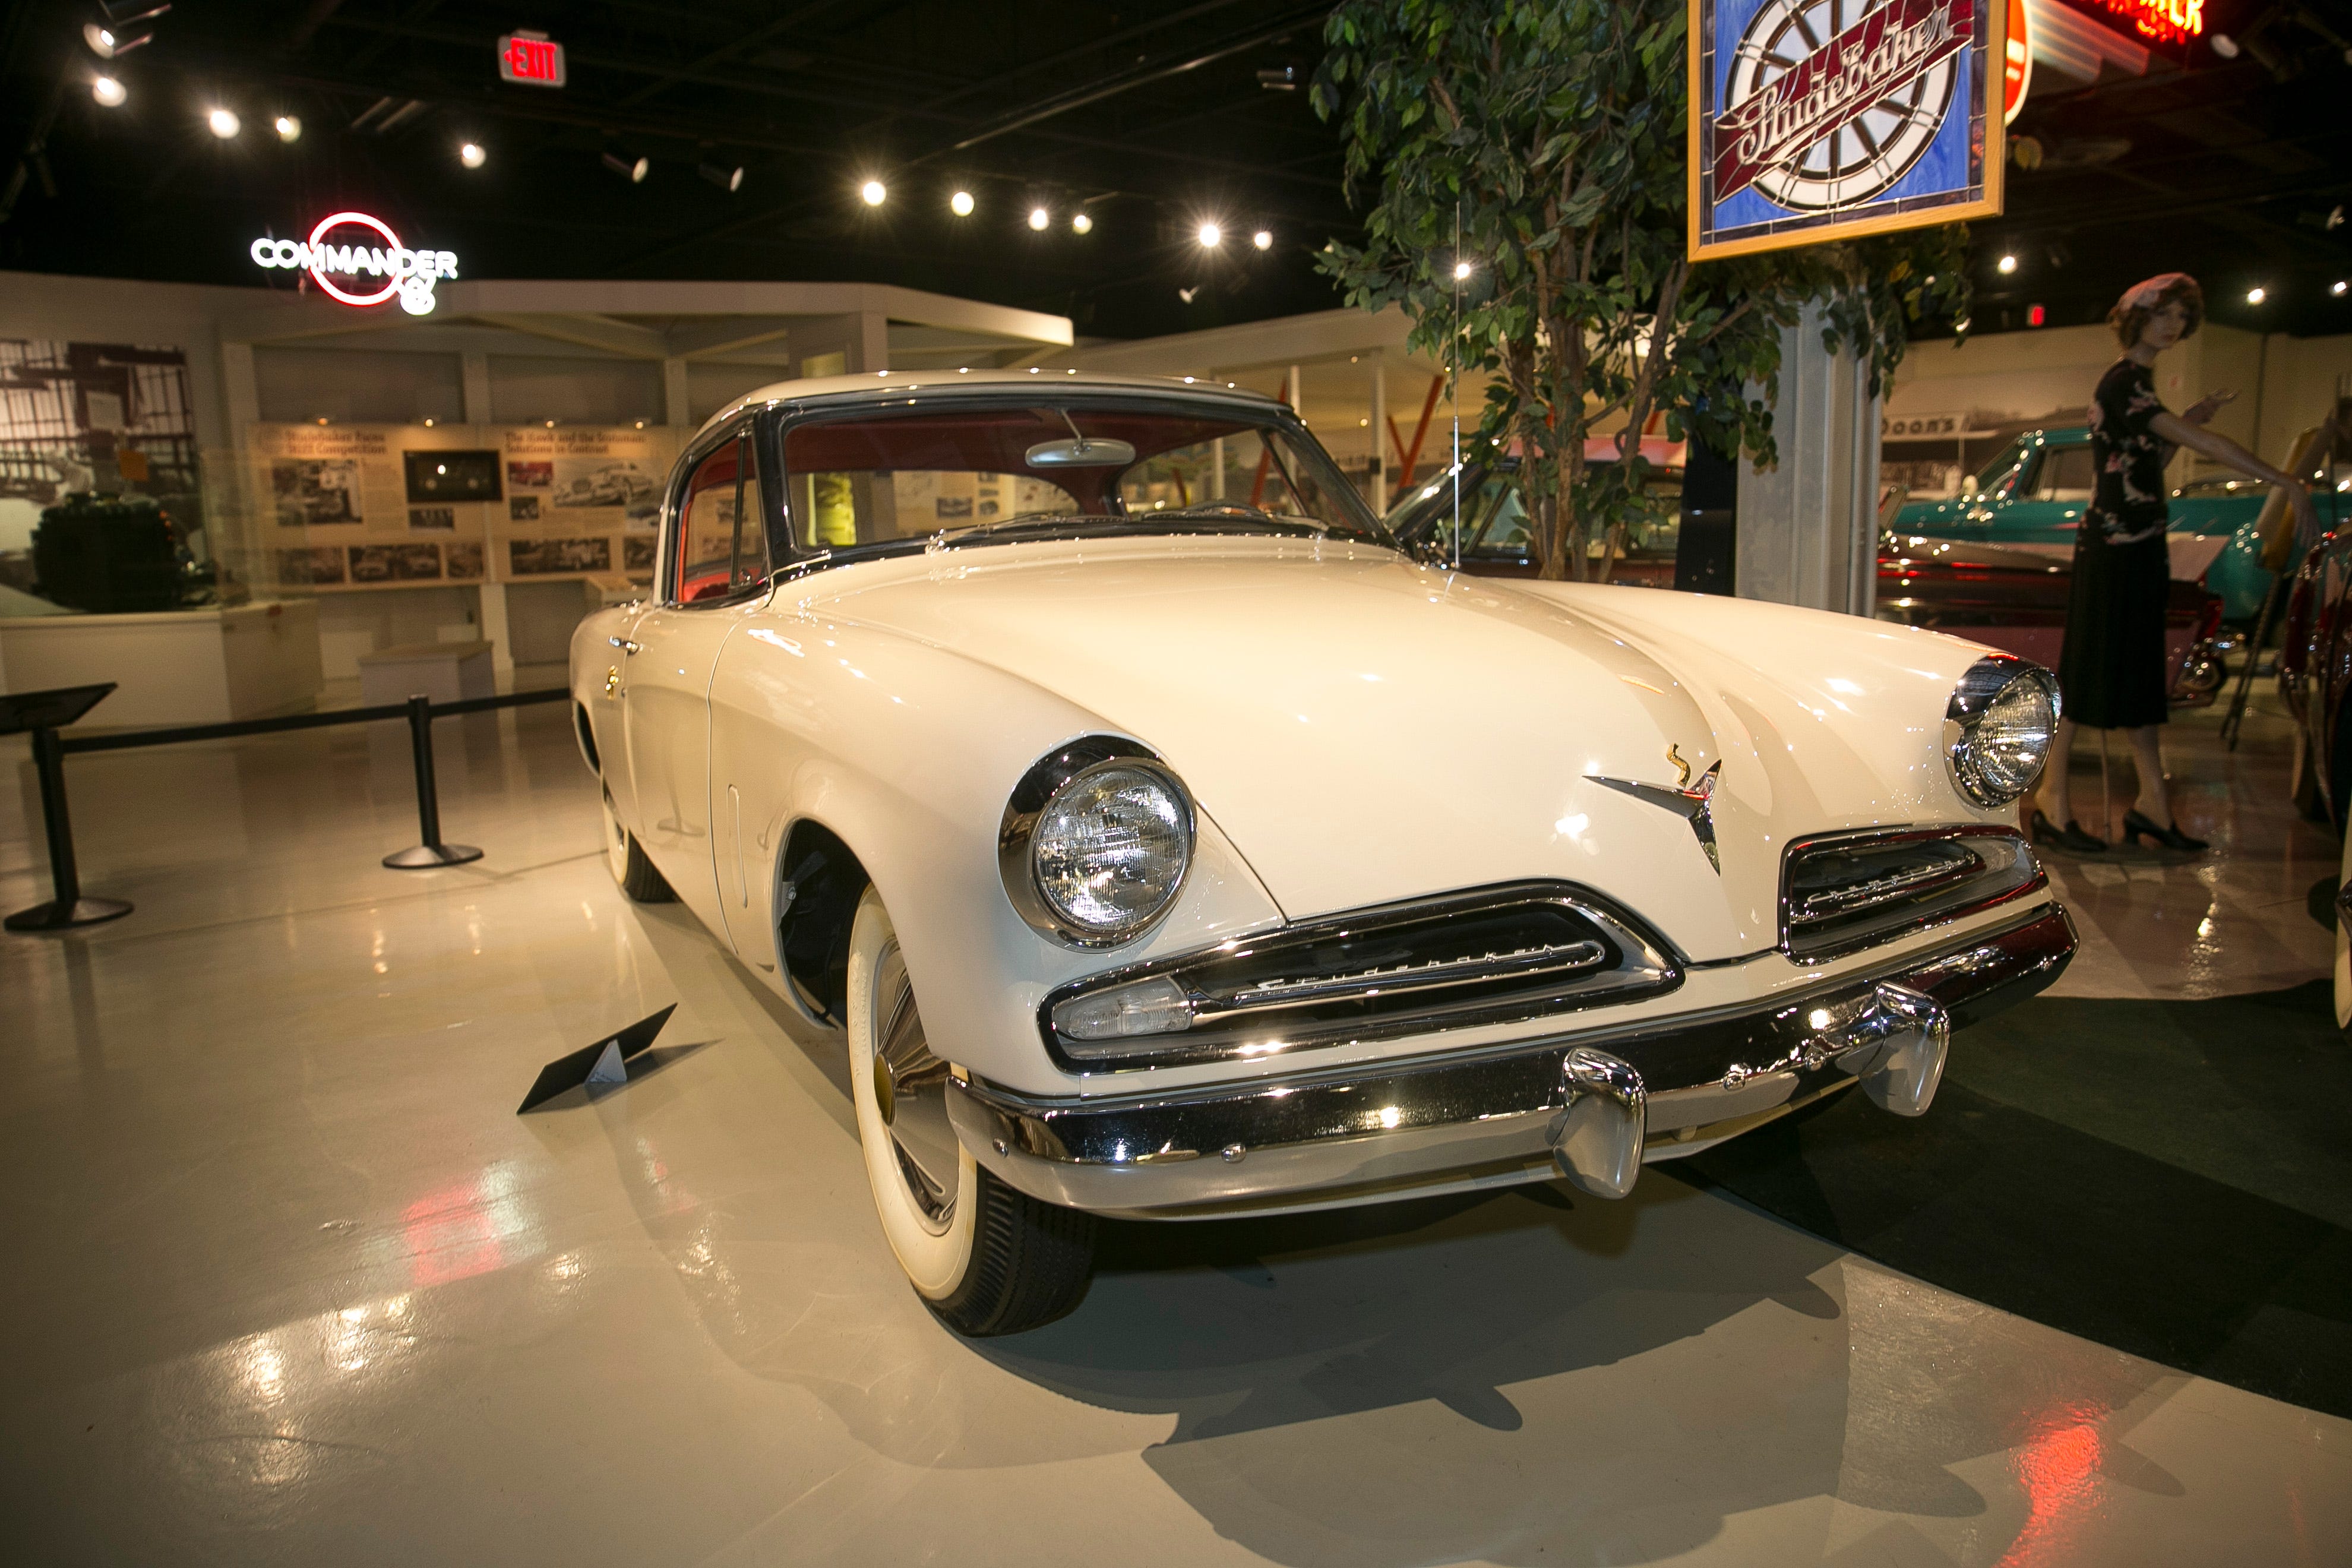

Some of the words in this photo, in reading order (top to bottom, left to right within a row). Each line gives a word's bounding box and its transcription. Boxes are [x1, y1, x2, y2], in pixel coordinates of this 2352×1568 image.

[511, 37, 557, 81] EXIT
[1737, 5, 1956, 165] Studebaker
[251, 238, 459, 279] COMMANDER
